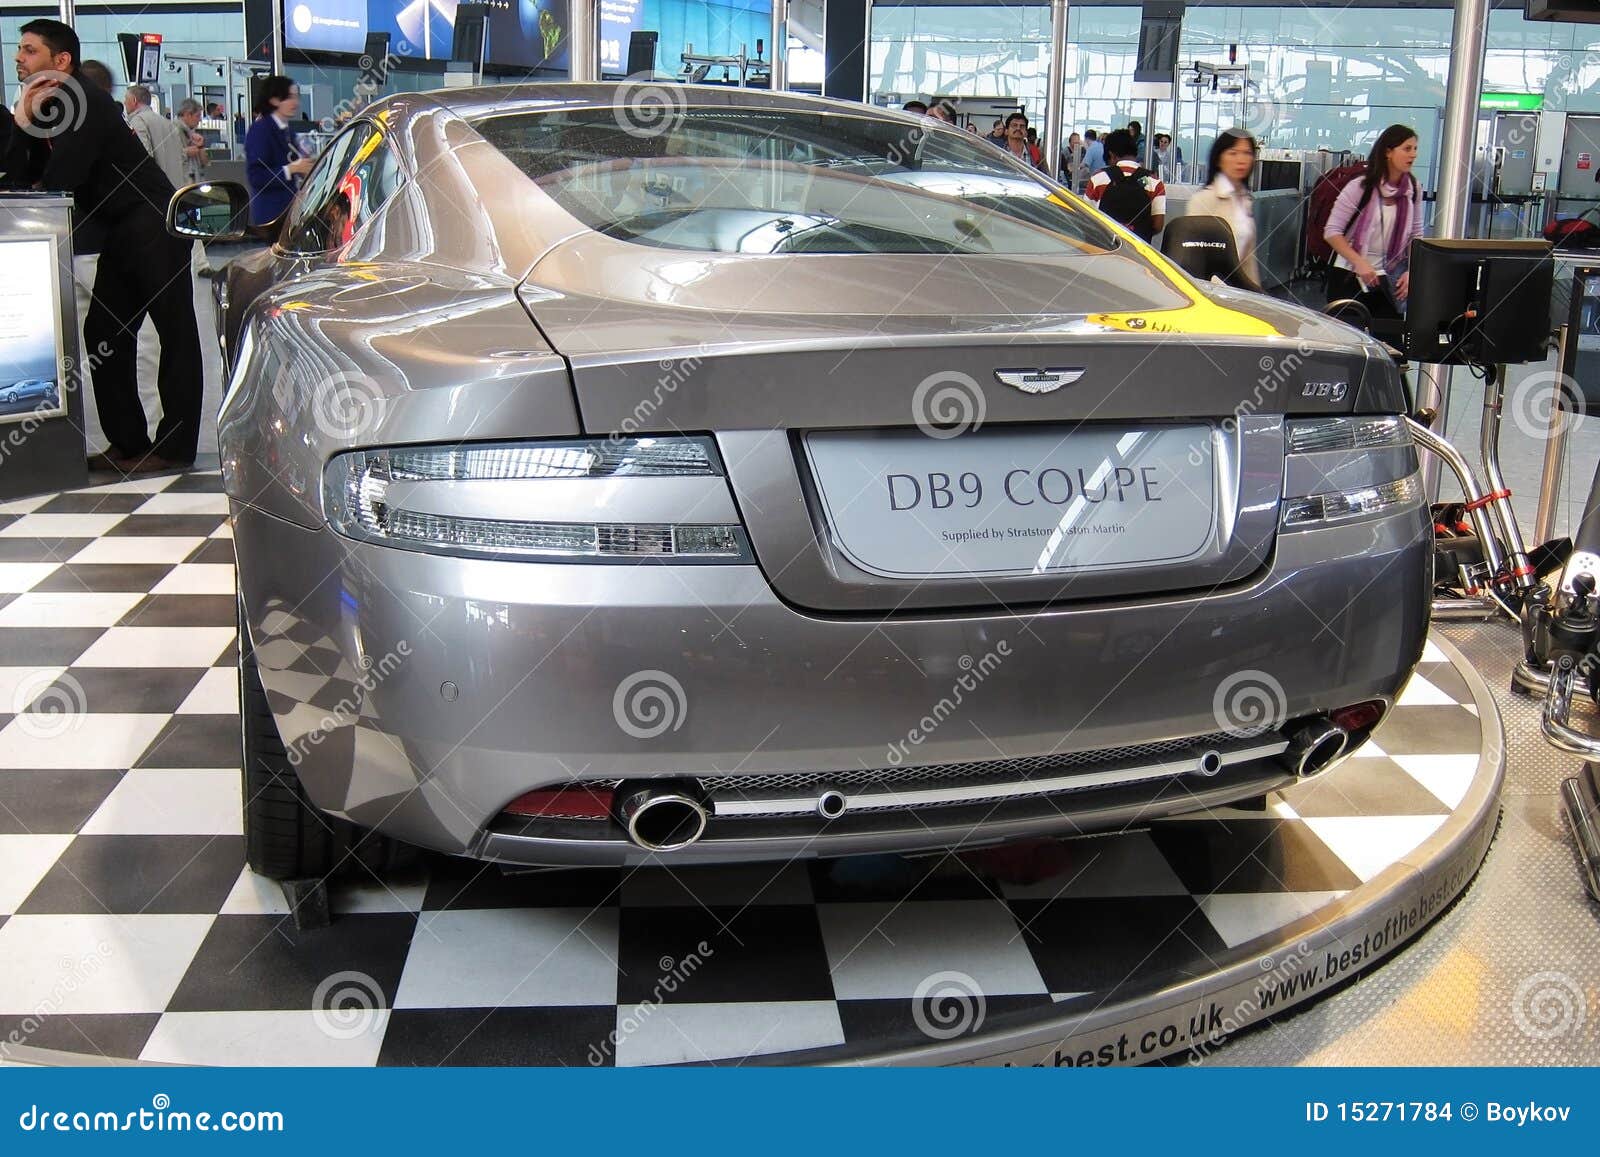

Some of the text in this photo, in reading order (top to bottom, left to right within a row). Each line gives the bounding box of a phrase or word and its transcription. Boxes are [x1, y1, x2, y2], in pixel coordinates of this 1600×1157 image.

[886, 466, 1162, 511] DB9 COUPE
[942, 528, 989, 543] Supplied
[992, 526, 1004, 540] by
[1007, 526, 1059, 538] Stratston
[1092, 522, 1126, 534] Martin
